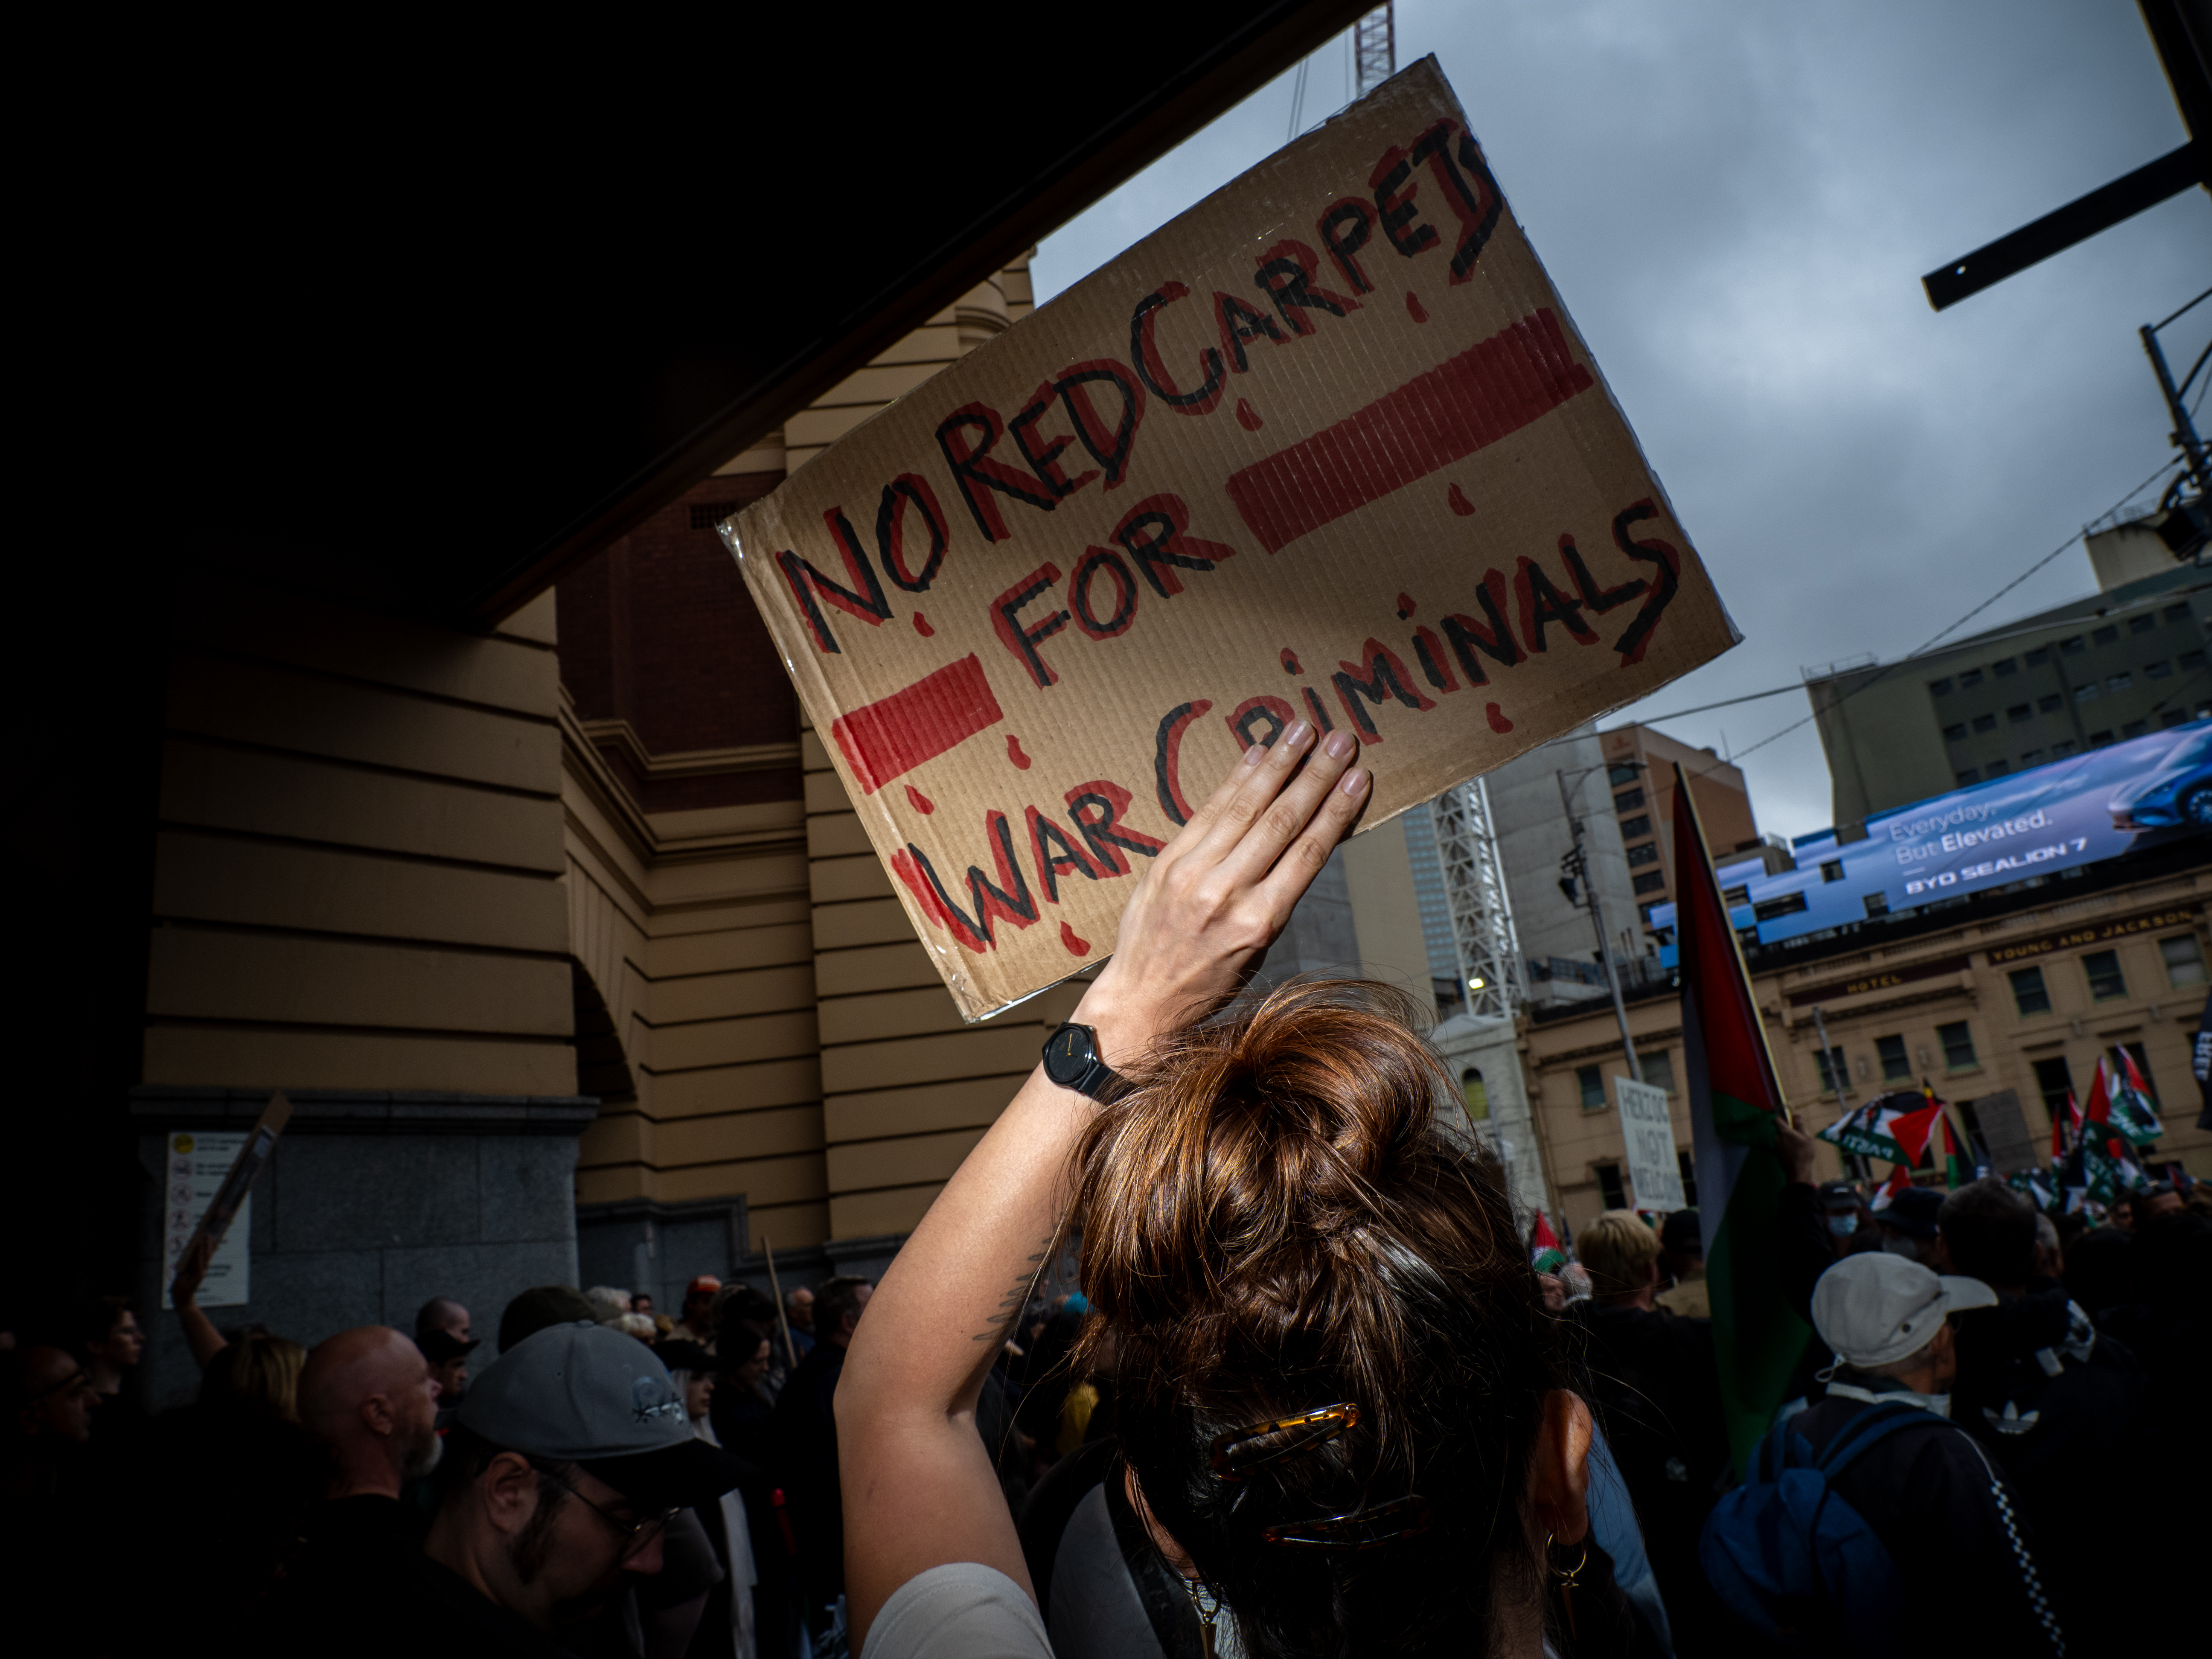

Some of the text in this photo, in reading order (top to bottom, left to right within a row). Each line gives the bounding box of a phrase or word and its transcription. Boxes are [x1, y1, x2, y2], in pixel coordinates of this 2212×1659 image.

[776, 117, 1503, 655] NO RED CARPETS
[990, 493, 1236, 691] FOR
[1889, 801, 1997, 841] Everyday.
[1895, 808, 2054, 865] But Elevated.
[891, 780, 1168, 954] WAR
[1961, 842, 2068, 881] SEALION
[2069, 836, 2088, 852] 7
[1992, 911, 2192, 961] YOUNG AND JACKSON
[1847, 975, 1903, 995] HOTEL
